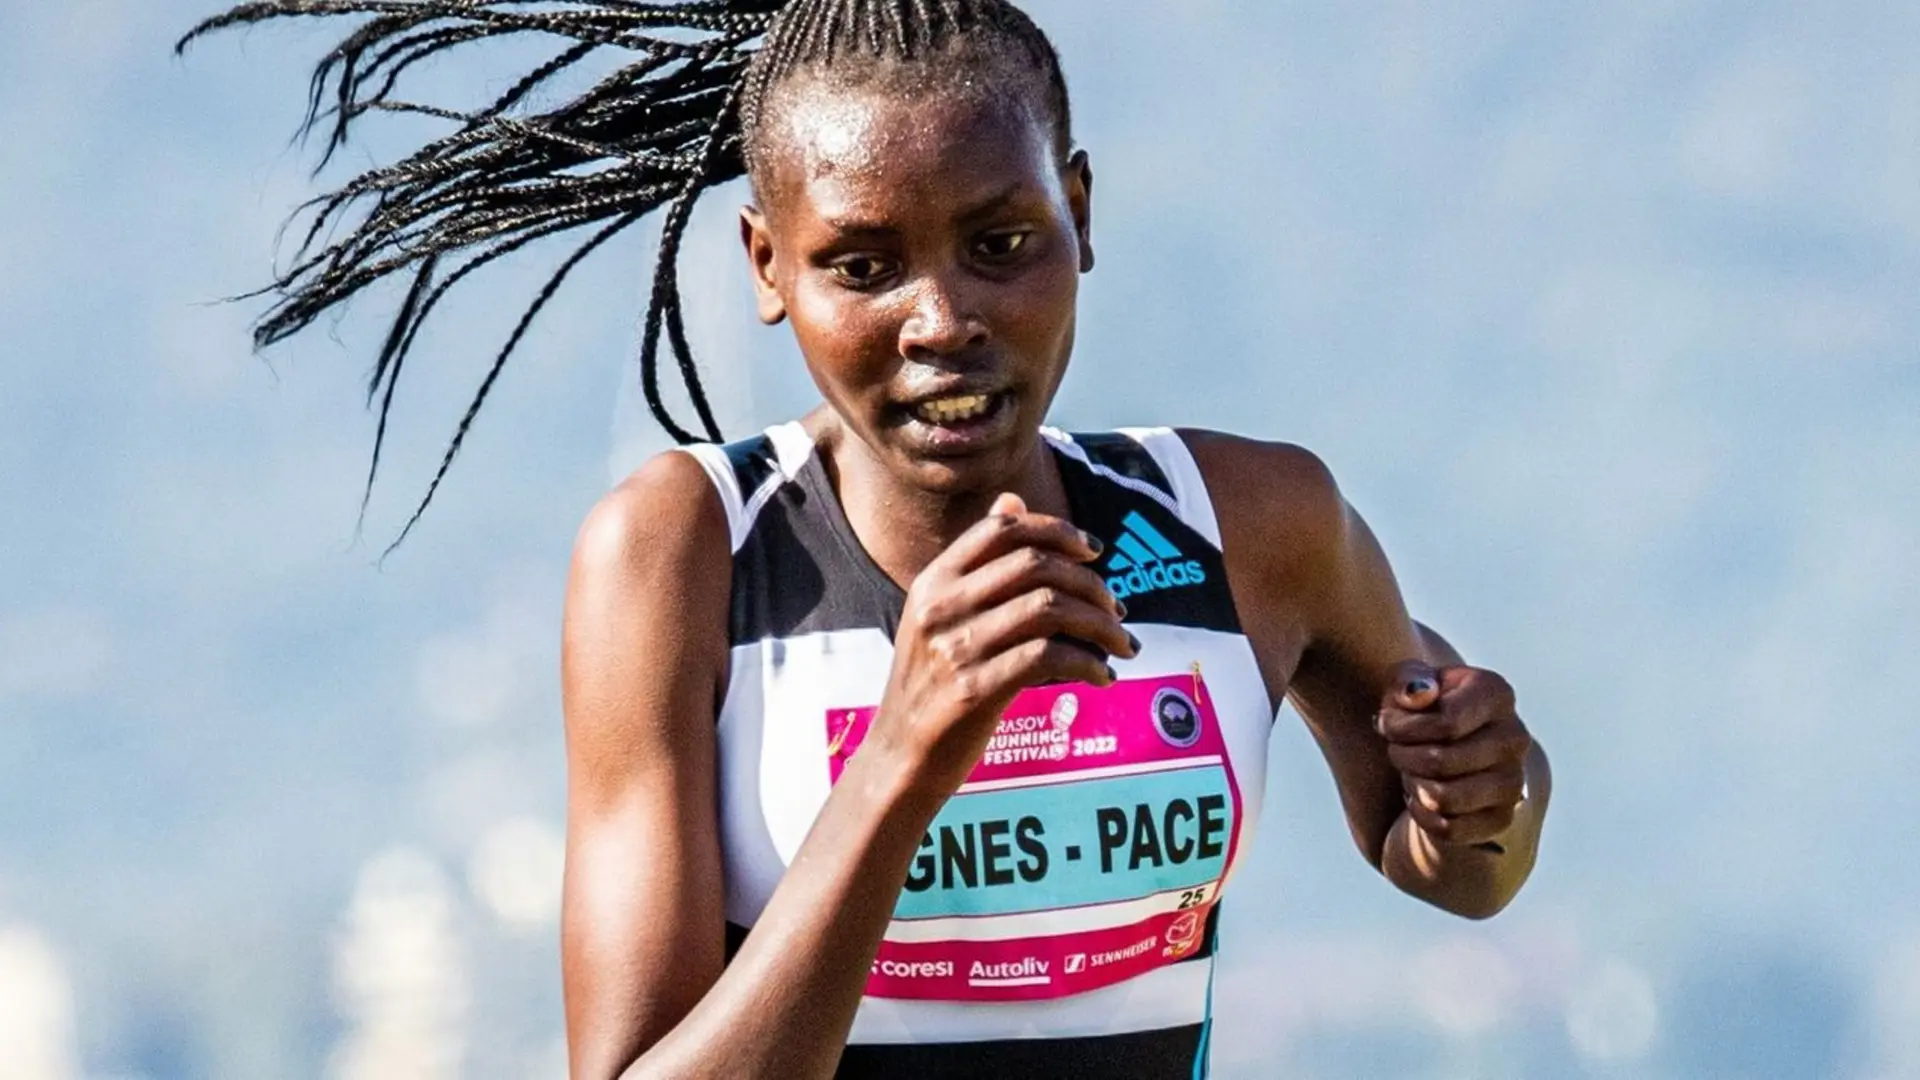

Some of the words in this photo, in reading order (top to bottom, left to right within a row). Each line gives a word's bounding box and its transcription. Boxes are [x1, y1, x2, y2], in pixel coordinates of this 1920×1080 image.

[1106, 560, 1206, 599] adidas
[995, 715, 1048, 734] RASOV
[984, 746, 1061, 766] FESTIVAL
[1072, 735, 1118, 757] 2022
[986, 728, 1062, 751] RUNNING
[903, 815, 1049, 892] GNES
[1096, 793, 1226, 874] PACE
[1178, 888, 1206, 910] 25
[1090, 935, 1158, 967] SENNHEISER
[969, 957, 1050, 979] Autoliv
